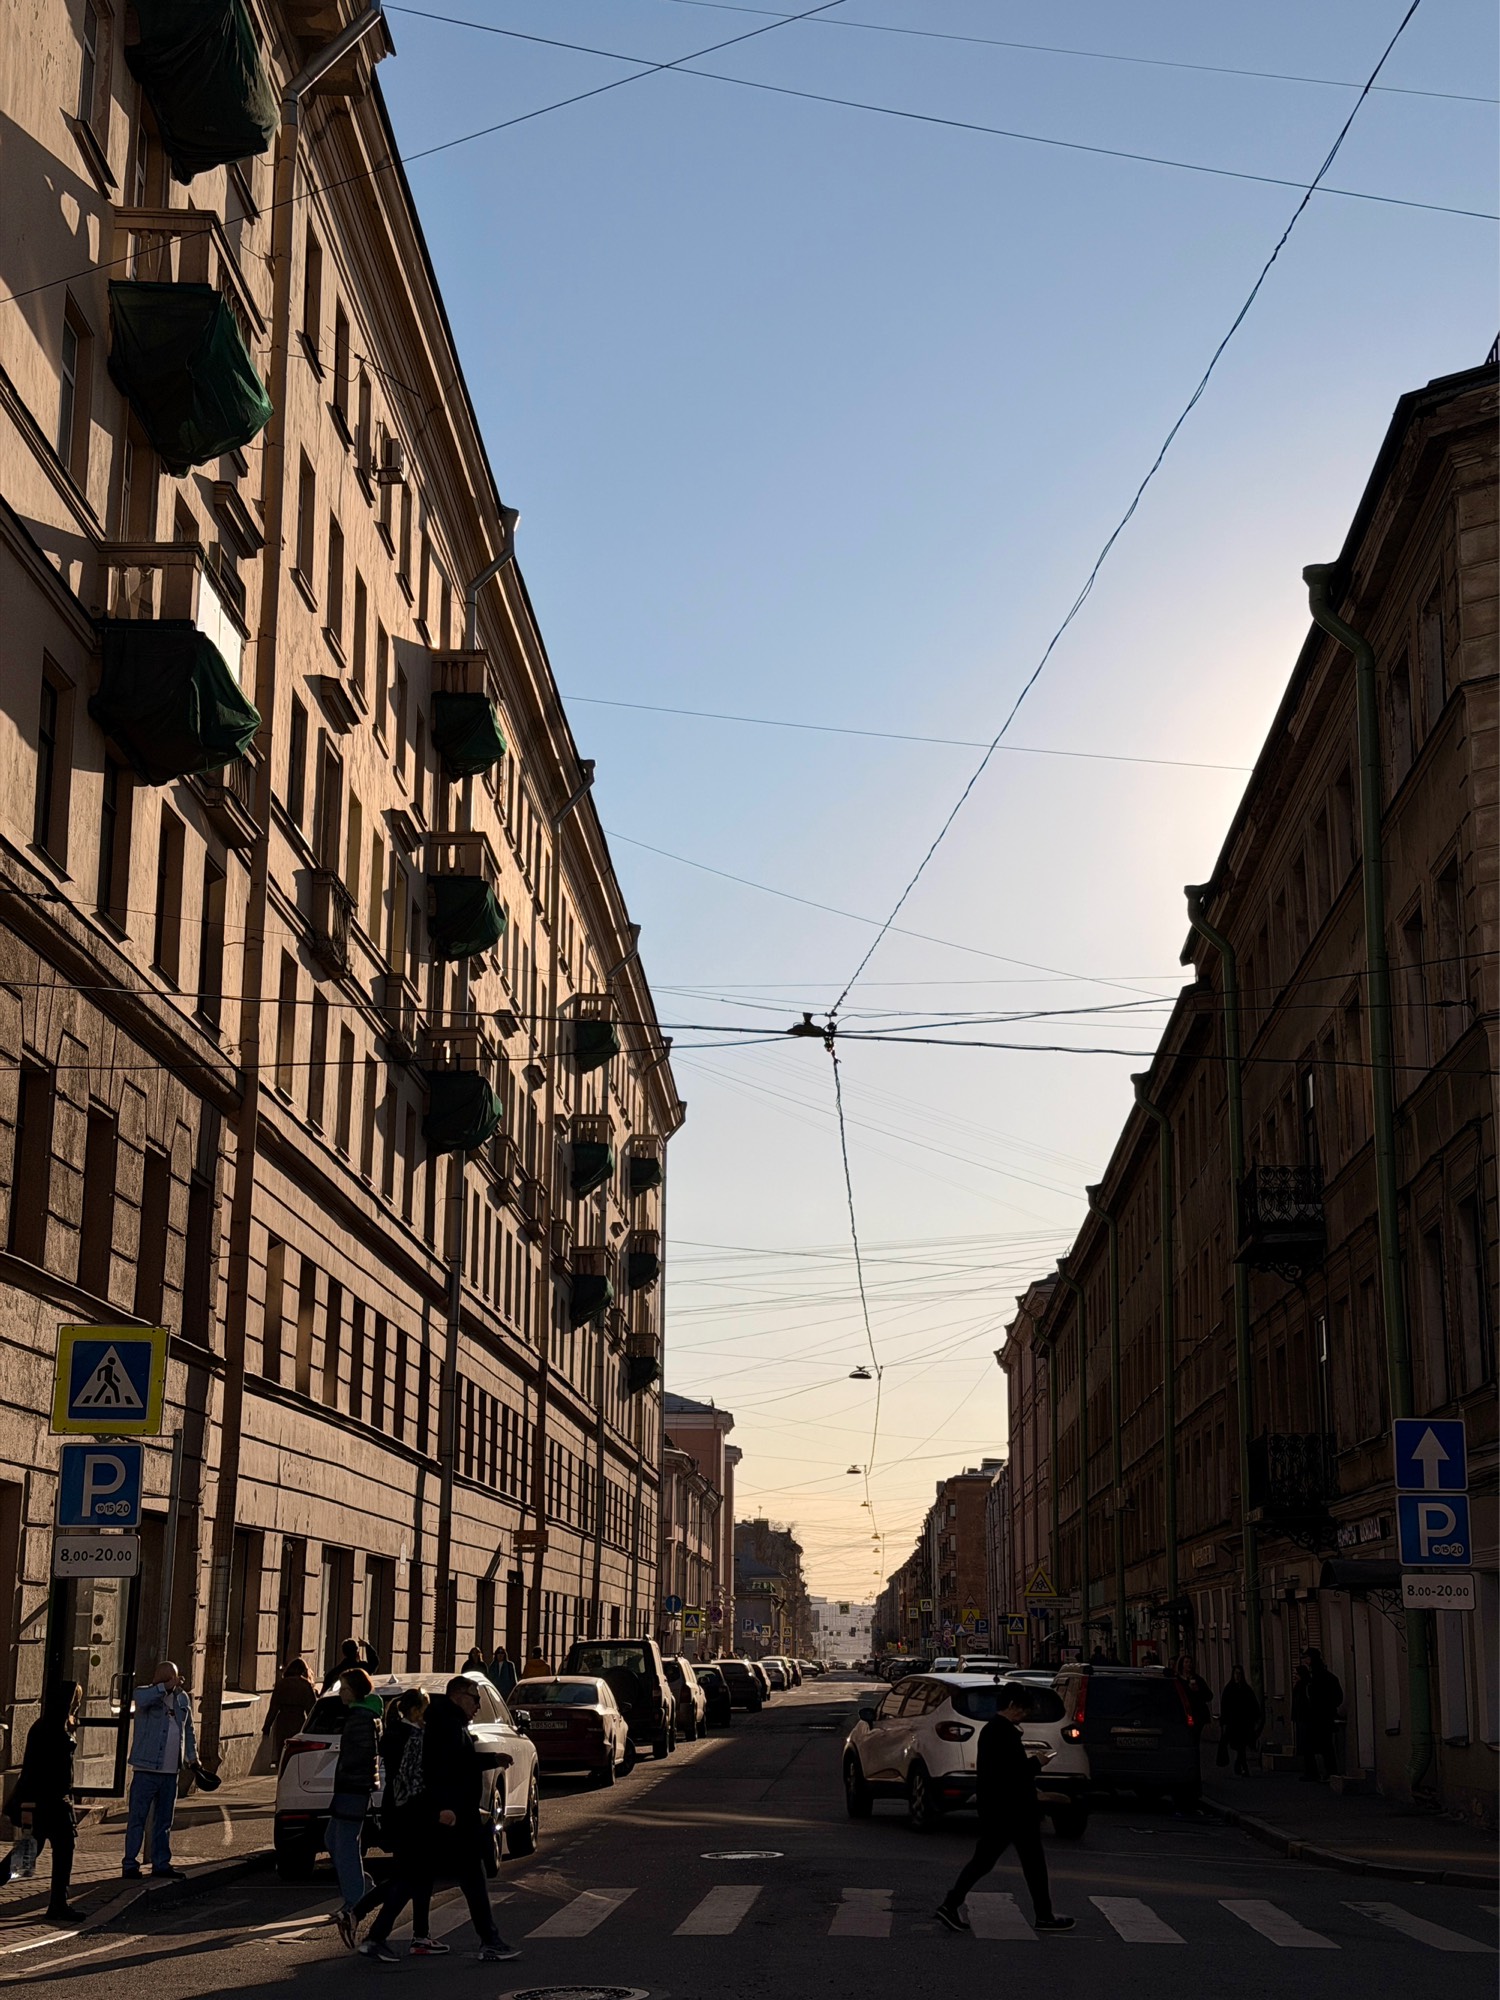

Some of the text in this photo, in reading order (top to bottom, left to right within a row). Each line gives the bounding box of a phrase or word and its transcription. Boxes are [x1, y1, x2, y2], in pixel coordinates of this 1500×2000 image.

[81, 1454, 126, 1517] P
[105, 1504, 114, 1512] 15
[116, 1504, 130, 1513] 20
[1417, 1502, 1457, 1557] P
[60, 1548, 132, 1562] 8.00-20.00
[1451, 1545, 1463, 1554] 20
[1407, 1584, 1469, 1597] 8.00-20.00
[978, 1620, 987, 1632] P
